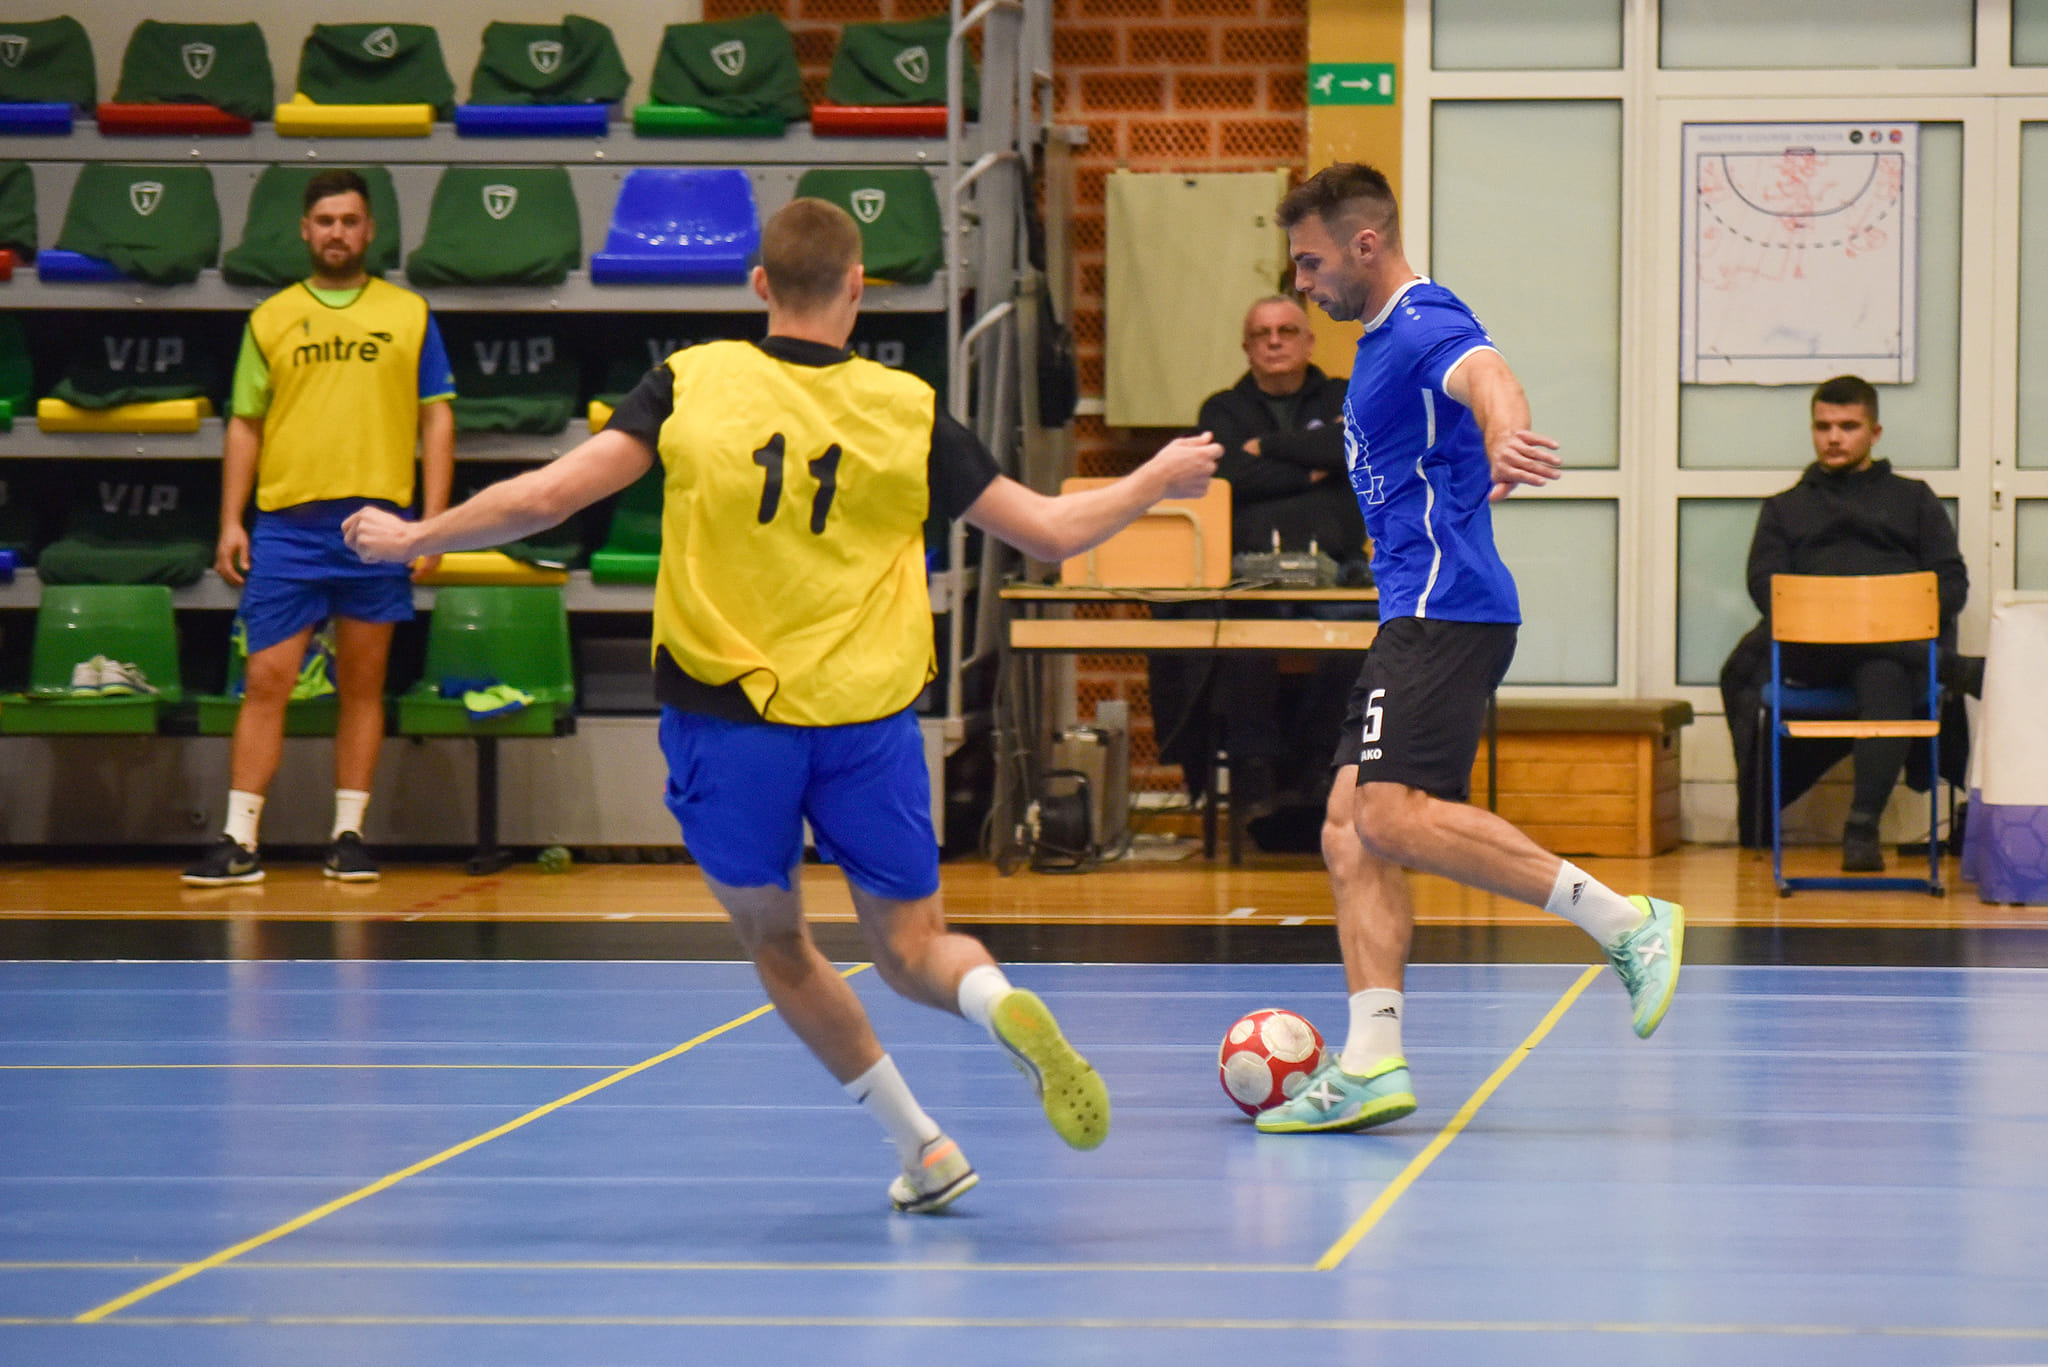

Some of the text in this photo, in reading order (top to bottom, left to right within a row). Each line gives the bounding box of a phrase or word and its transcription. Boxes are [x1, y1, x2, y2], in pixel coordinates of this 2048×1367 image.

[104, 336, 184, 372] VIP
[293, 335, 380, 367] mitre
[474, 337, 554, 375] VIP
[99, 481, 178, 516] VIP
[752, 432, 842, 535] 11
[1363, 688, 1386, 743] 5
[1361, 748, 1383, 762] AKO
